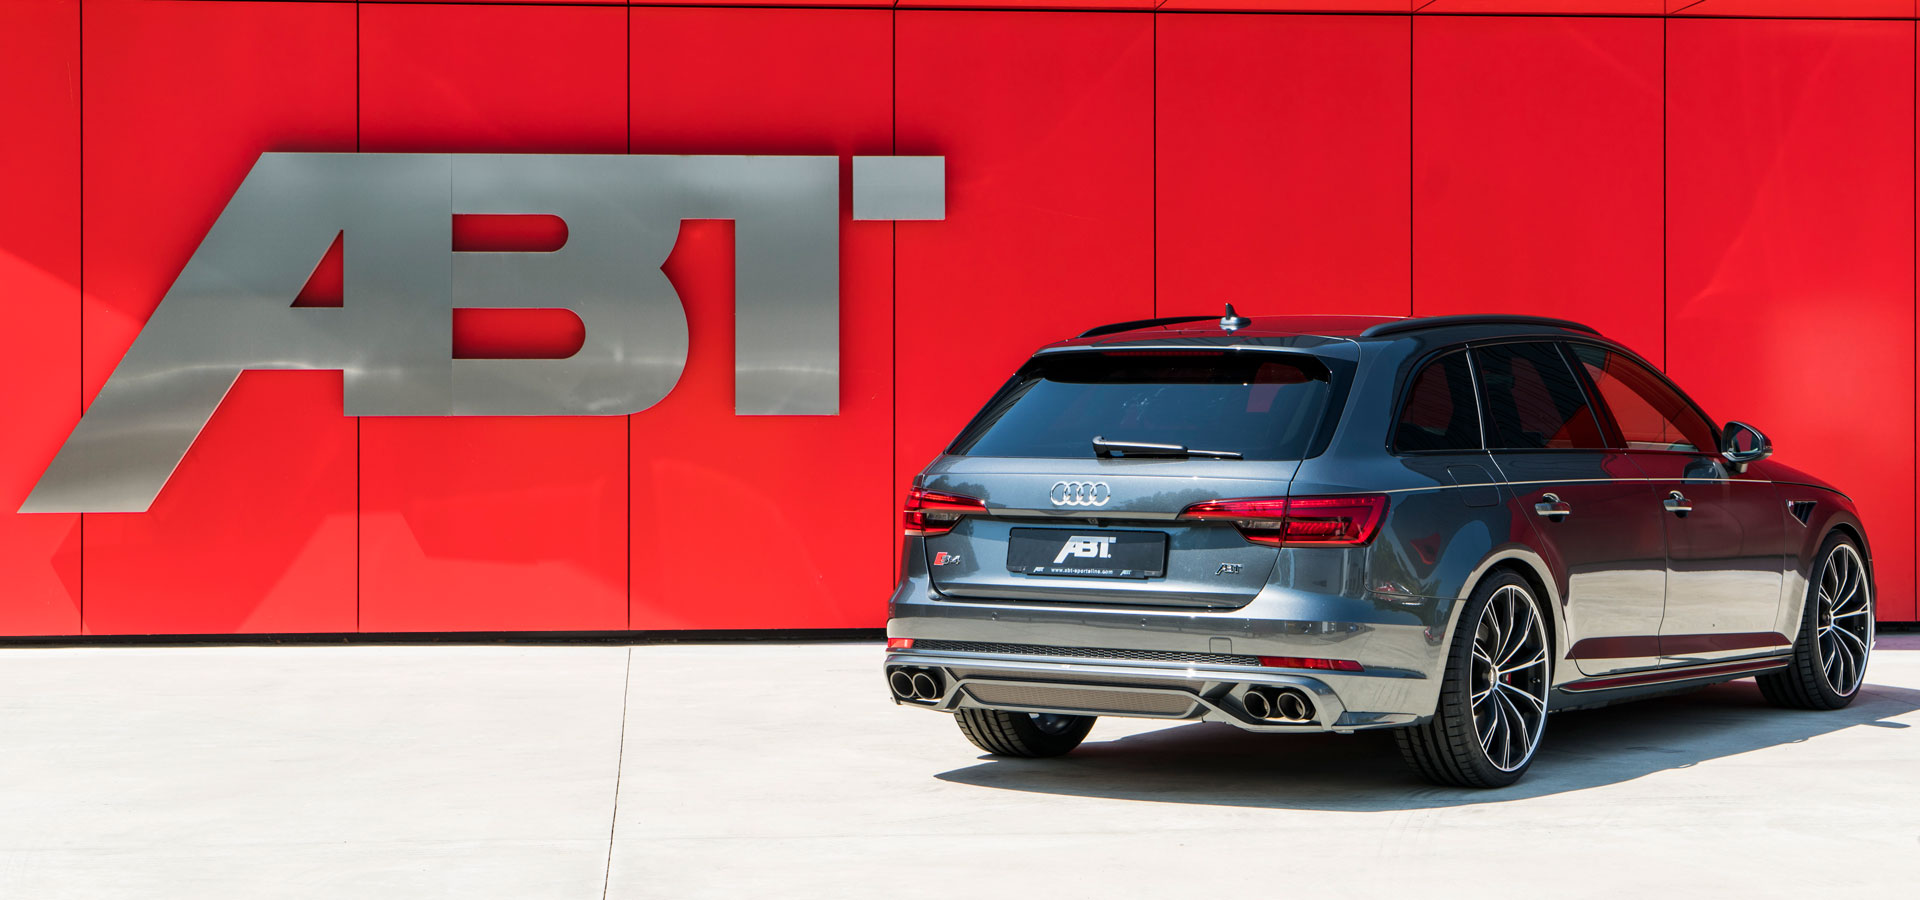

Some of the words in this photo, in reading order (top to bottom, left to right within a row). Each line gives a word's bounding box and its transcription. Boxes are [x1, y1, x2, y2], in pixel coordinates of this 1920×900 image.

[17, 151, 842, 513] ABT
[1053, 535, 1116, 564] ABT
[1051, 567, 1113, 575] www.abt-sportsline.com
[1214, 562, 1242, 576] ABT
